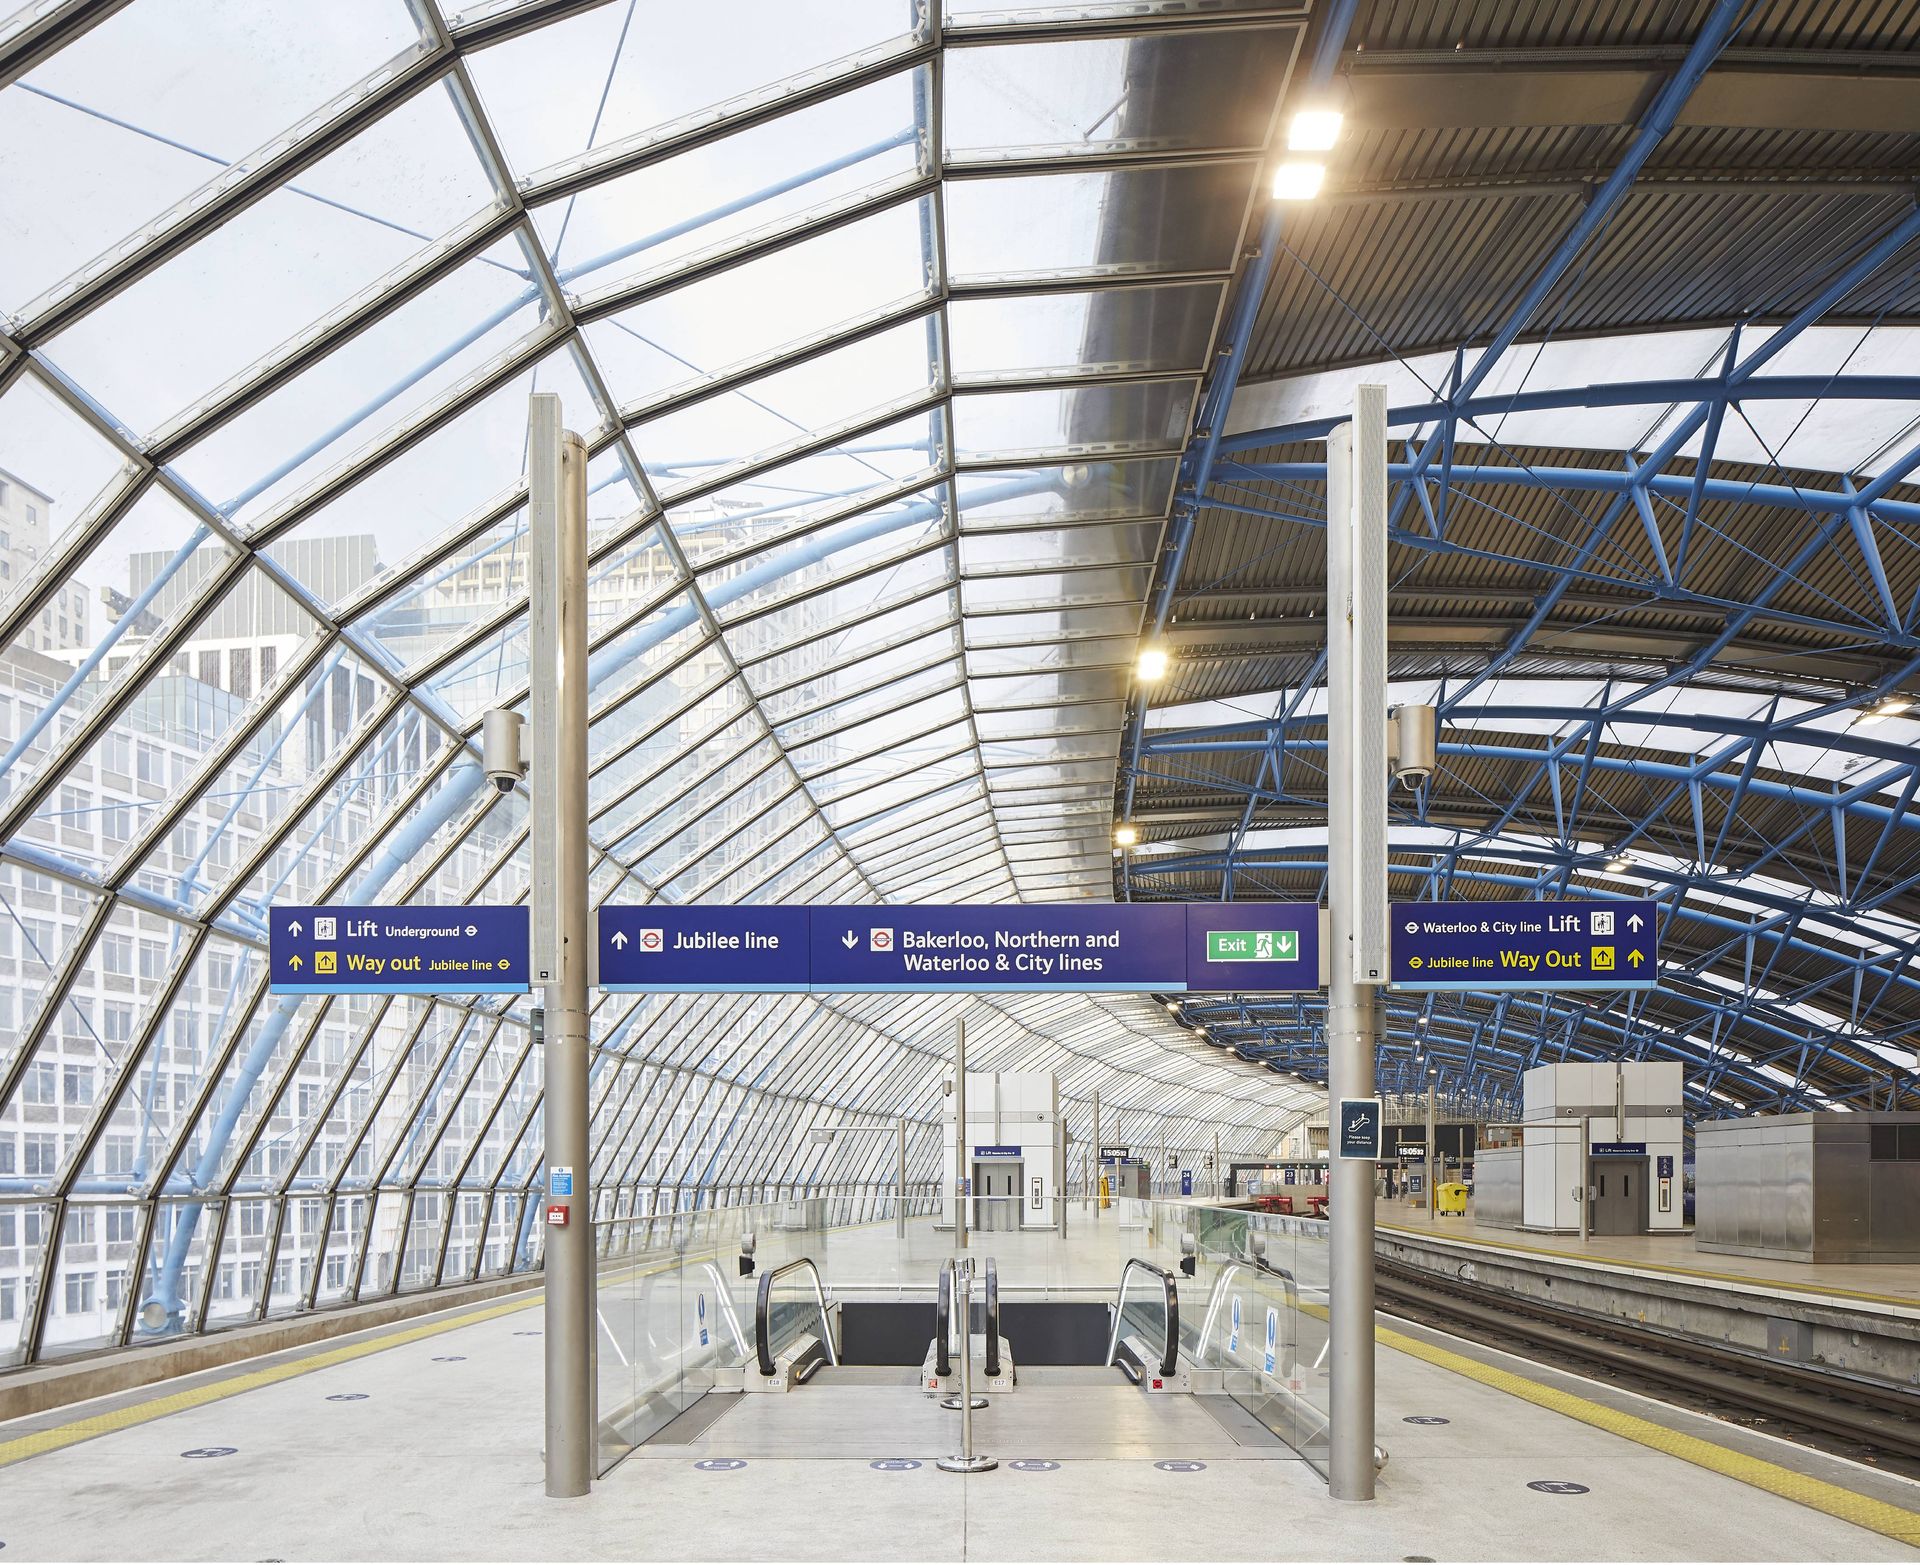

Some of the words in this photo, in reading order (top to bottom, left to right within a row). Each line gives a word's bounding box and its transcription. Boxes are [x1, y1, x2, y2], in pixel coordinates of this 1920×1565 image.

[347, 920, 378, 937] Lift
[386, 925, 460, 940] Underground
[1423, 922, 1478, 933] Waterloo
[1480, 922, 1490, 933] &
[1492, 921, 1518, 935] City
[1520, 921, 1542, 933] line
[1548, 915, 1581, 932] Lift
[672, 931, 740, 950] Jubilee
[745, 931, 779, 949] line
[903, 930, 989, 950] Bakerloo,
[995, 929, 1080, 949] Northern
[1086, 930, 1120, 948] and
[1218, 936, 1247, 953] Exit
[347, 954, 386, 975] Way
[390, 955, 422, 972] out
[429, 959, 469, 972] Jubilee
[471, 959, 493, 971] line
[903, 953, 990, 972] Waterloo
[994, 953, 1010, 971] &
[1015, 953, 1055, 975] City
[1059, 953, 1103, 971] lines
[1427, 956, 1470, 969] Jubilee
[1472, 956, 1494, 968] line
[1499, 950, 1541, 972] Way
[1545, 950, 1582, 968] Out
